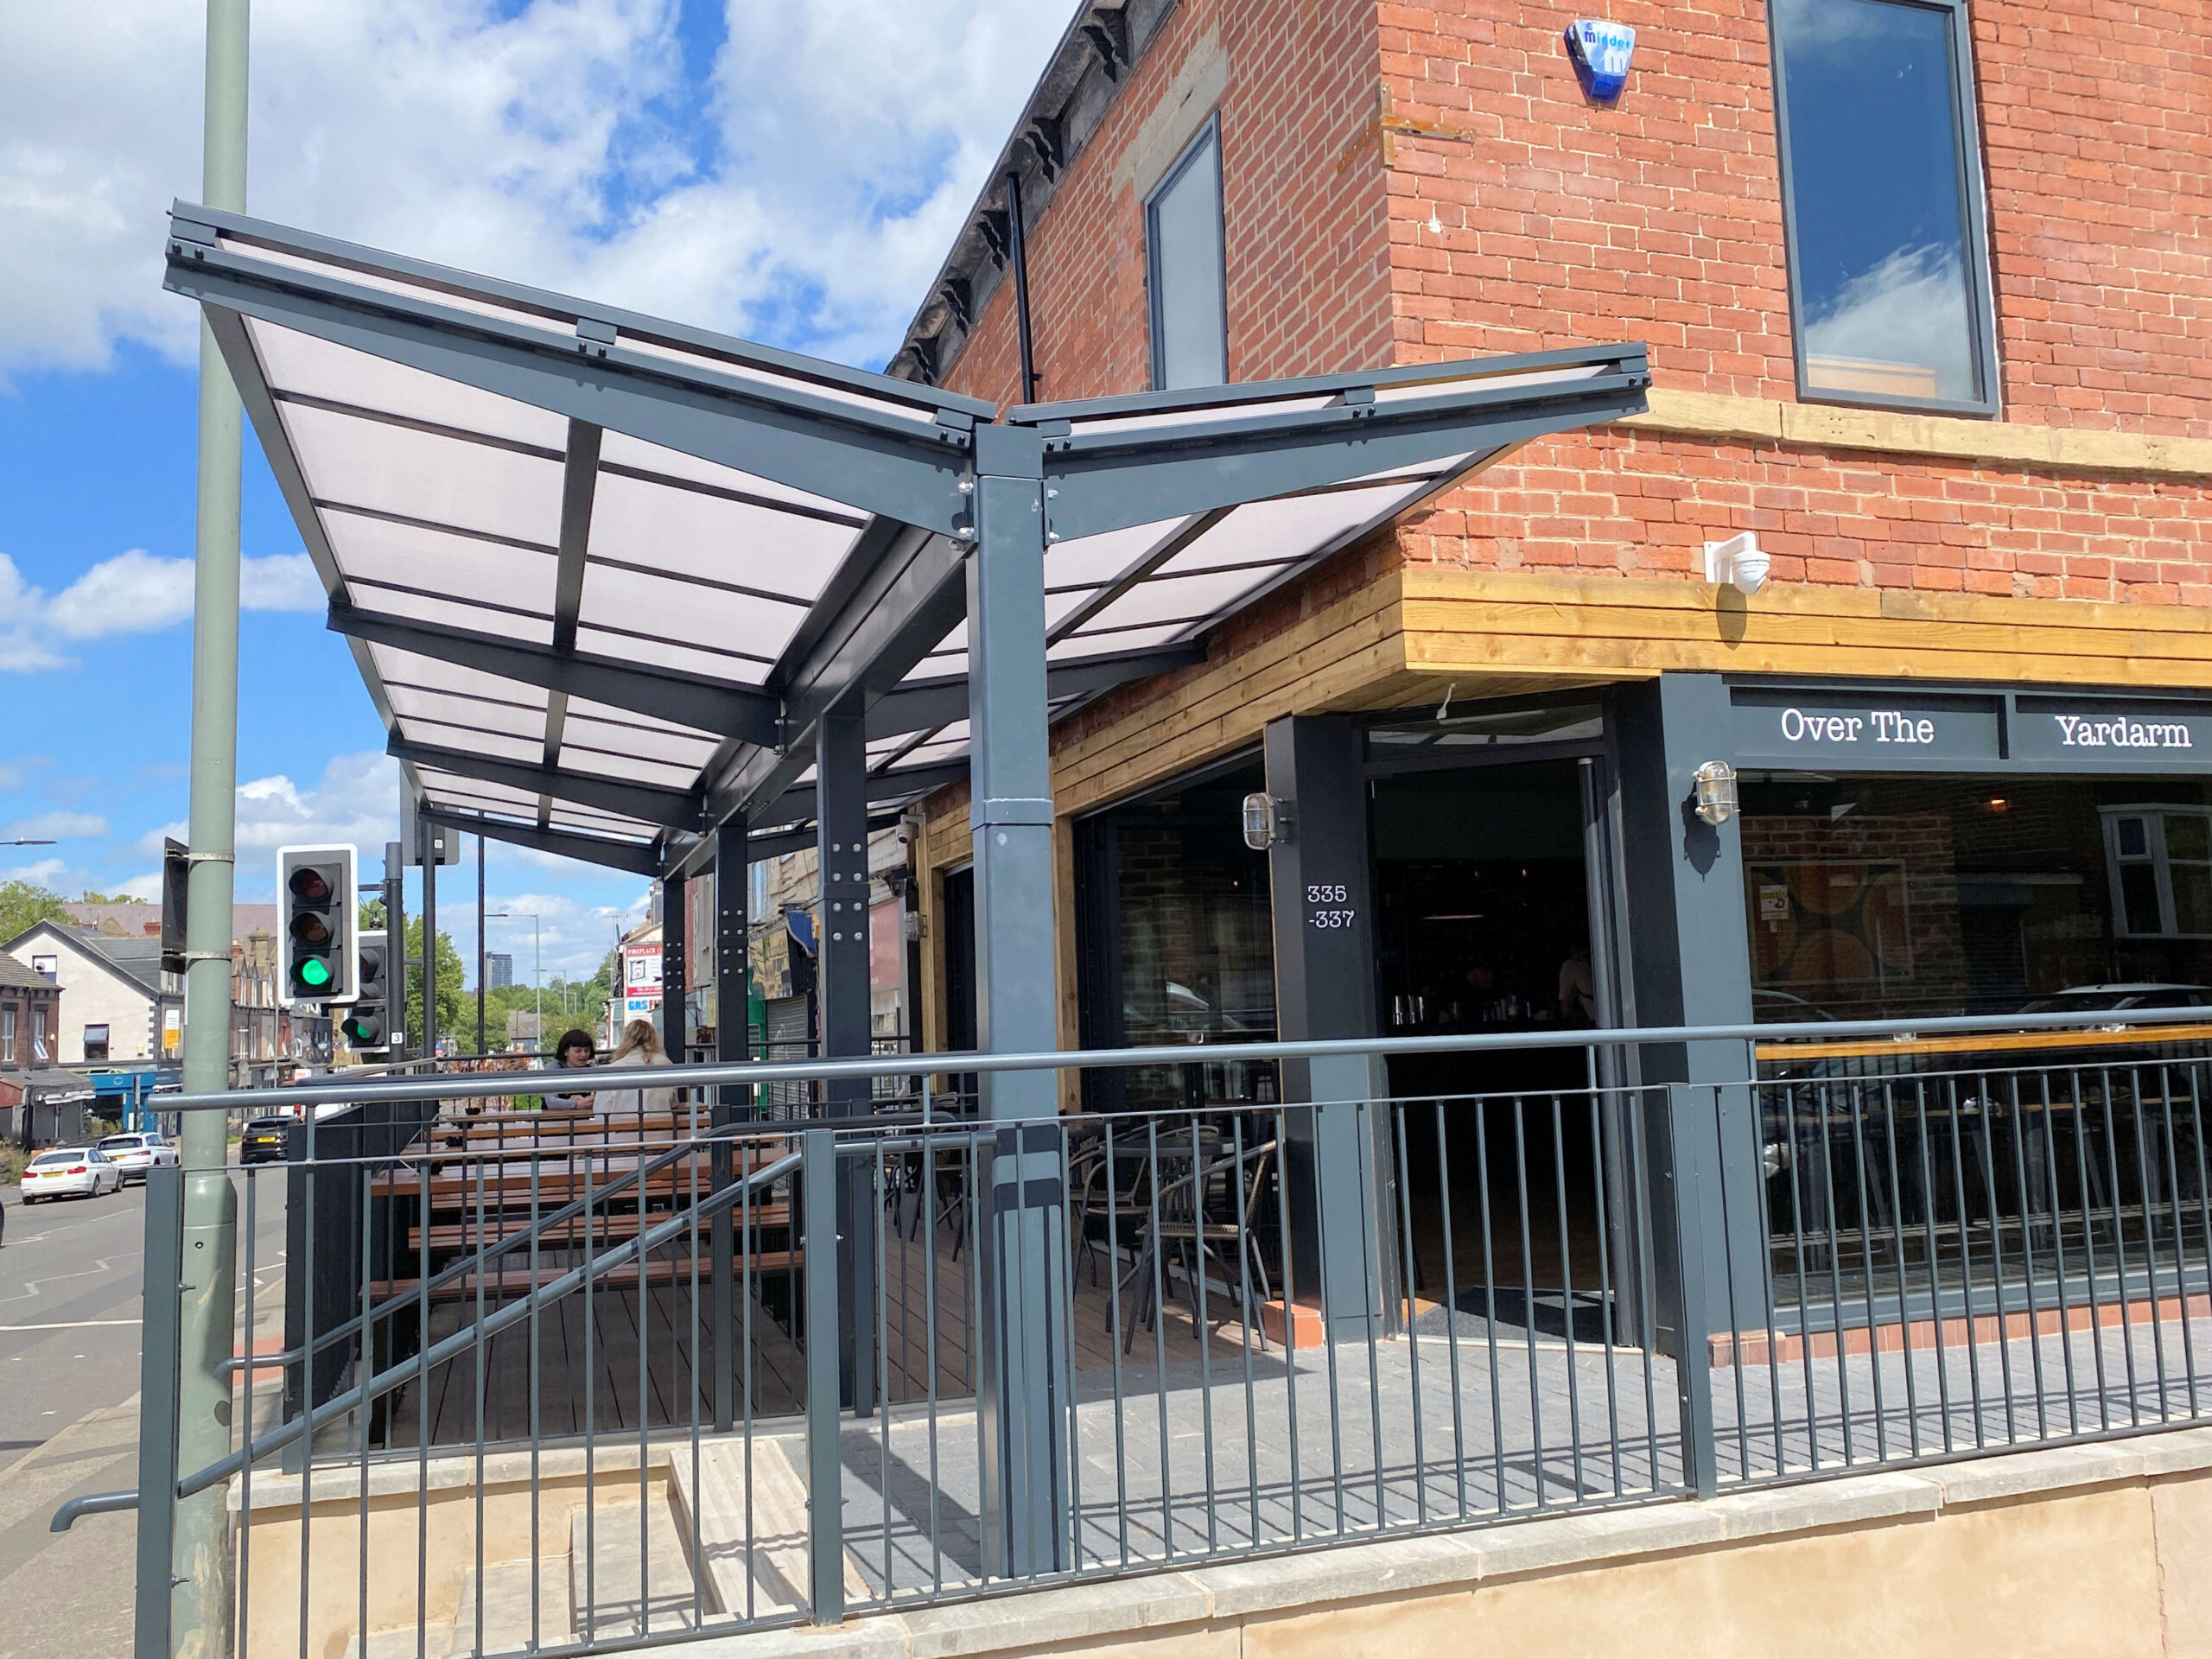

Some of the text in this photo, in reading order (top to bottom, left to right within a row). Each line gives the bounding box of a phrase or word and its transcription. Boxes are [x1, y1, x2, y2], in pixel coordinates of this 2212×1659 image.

[1781, 708, 1935, 743] Over The
[2054, 715, 2193, 747] Yardarm
[1307, 885, 1347, 903] 335
[1308, 909, 1355, 928] -337
[628, 1000, 648, 1010] GAS
